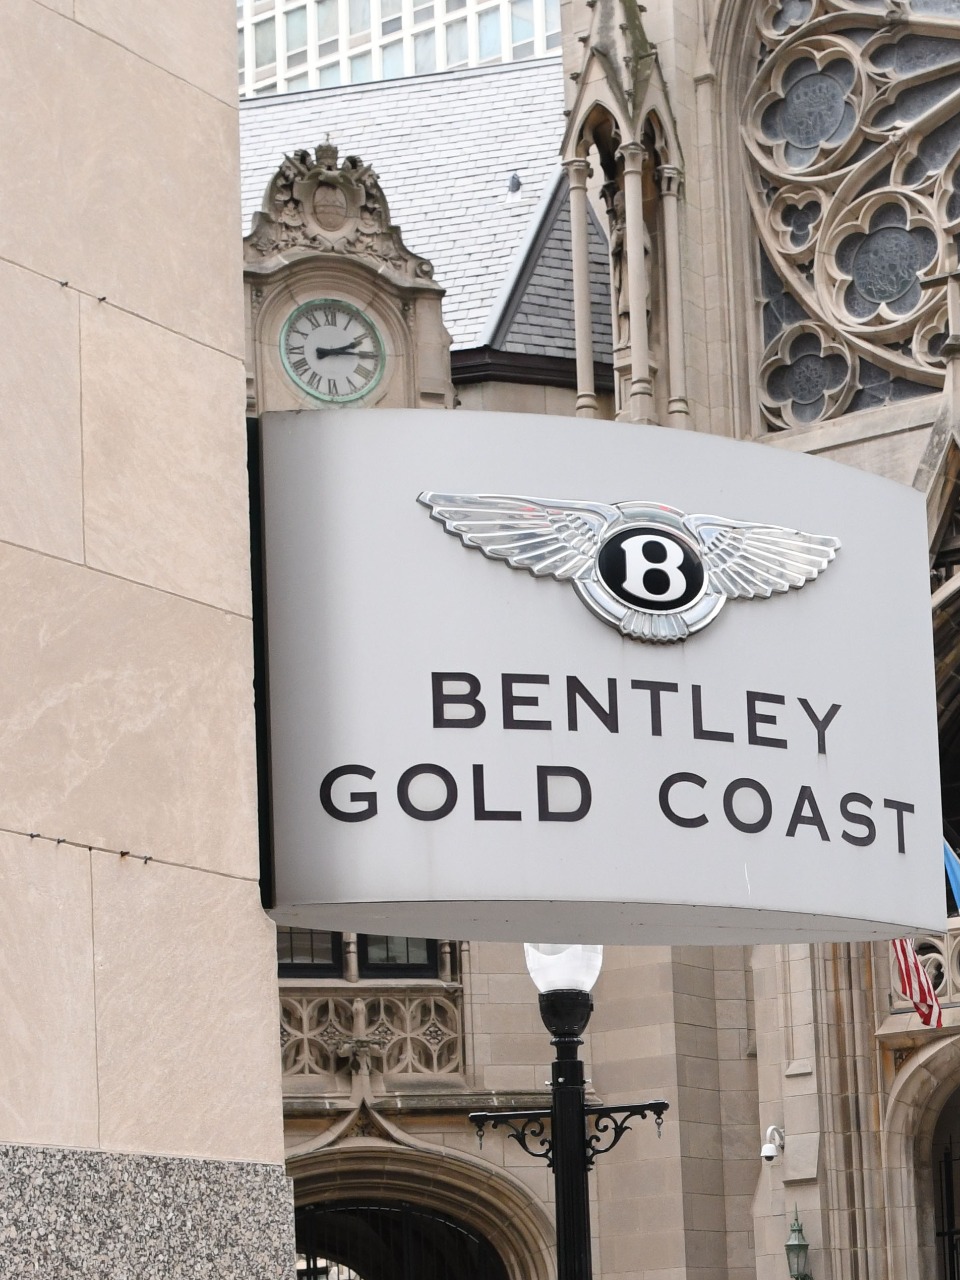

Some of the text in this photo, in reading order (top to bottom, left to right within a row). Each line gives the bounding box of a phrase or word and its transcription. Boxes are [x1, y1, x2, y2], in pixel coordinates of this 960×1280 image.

[324, 310, 337, 327] XII
[622, 534, 685, 603] B
[431, 671, 842, 755] BENTLEY
[319, 763, 915, 854] GOLD COAST
